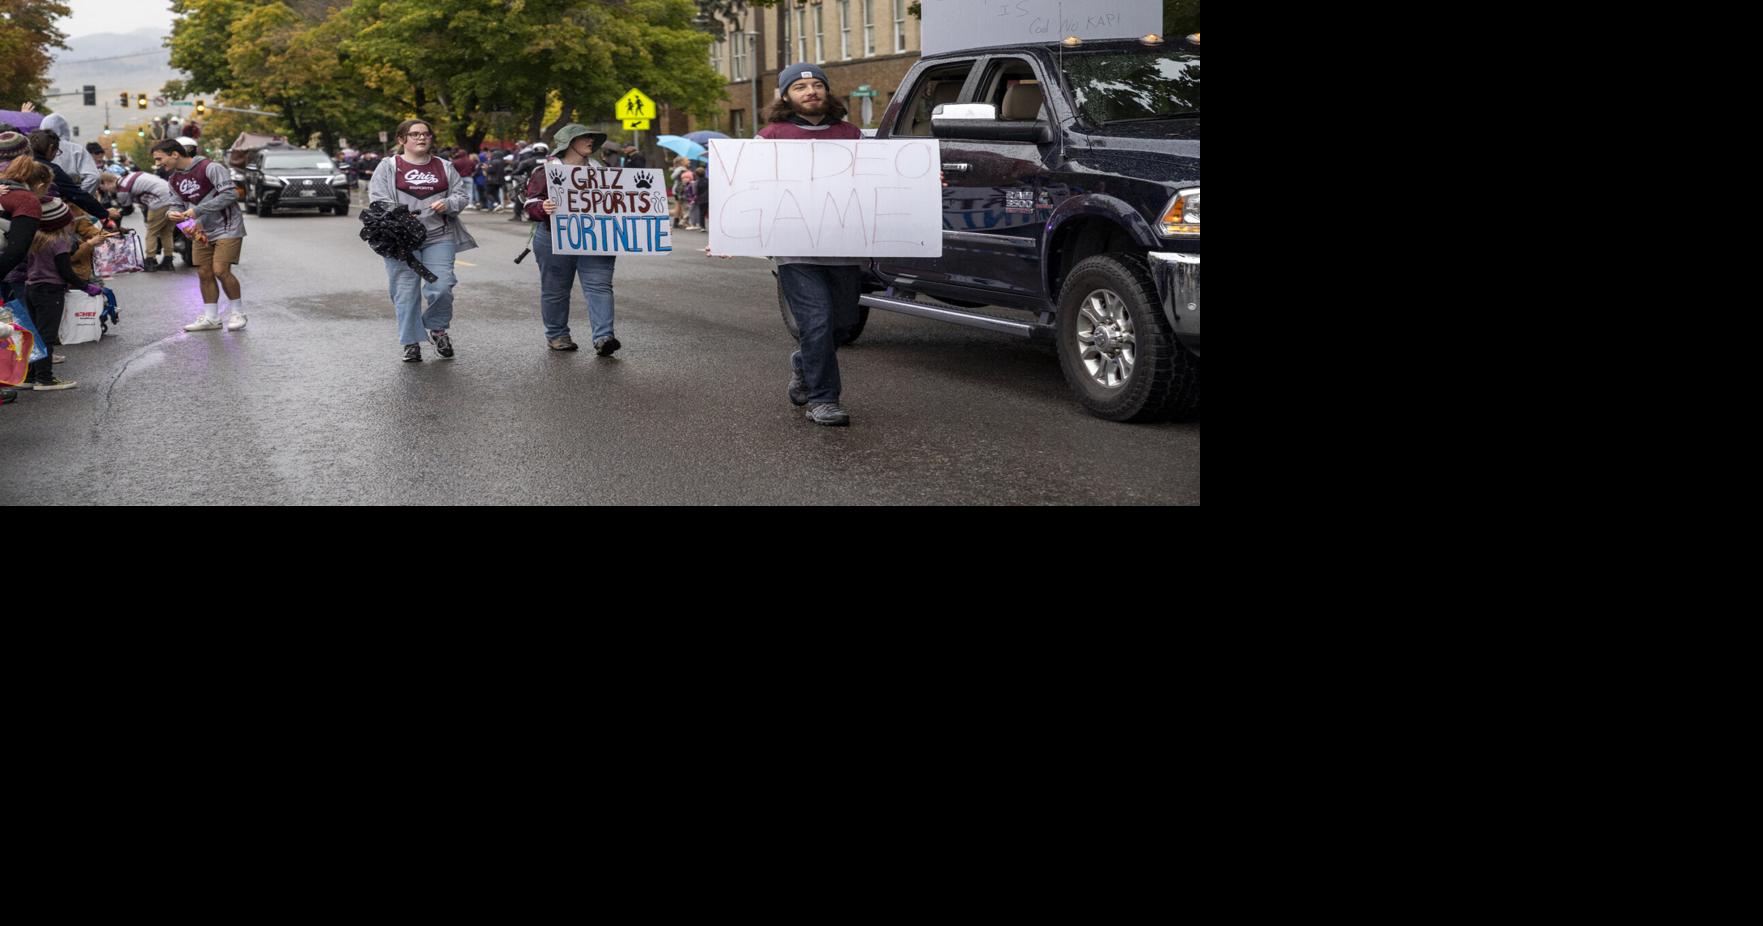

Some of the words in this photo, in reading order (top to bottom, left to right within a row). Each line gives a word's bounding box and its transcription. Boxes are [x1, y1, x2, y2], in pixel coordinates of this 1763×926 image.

[404, 169, 439, 183] Griz
[571, 167, 623, 190] GRIZ
[710, 139, 932, 187] VIDEO
[567, 188, 651, 214] ESPORTS
[556, 213, 673, 252] FORTNITE
[720, 187, 920, 248] GAME
